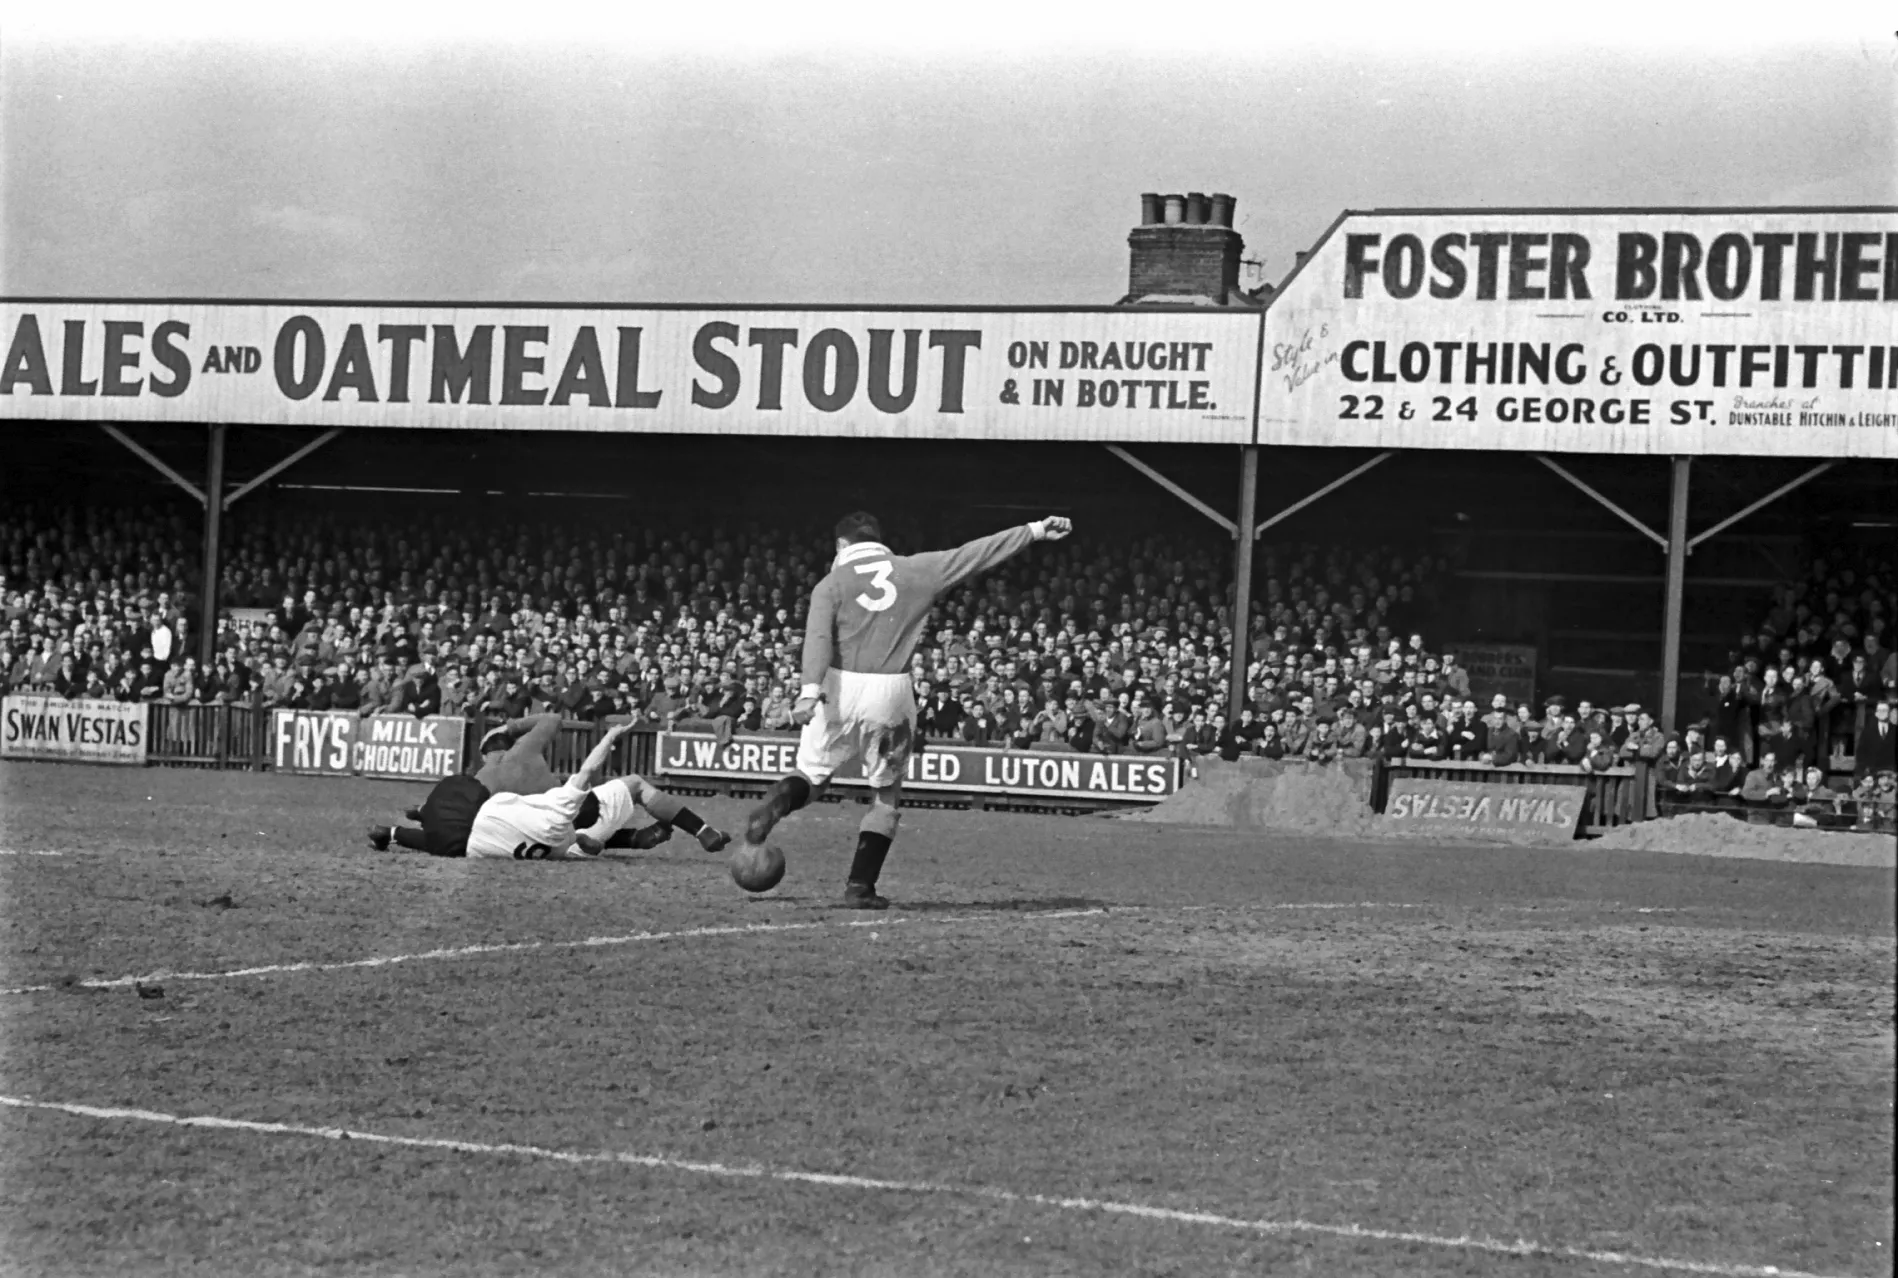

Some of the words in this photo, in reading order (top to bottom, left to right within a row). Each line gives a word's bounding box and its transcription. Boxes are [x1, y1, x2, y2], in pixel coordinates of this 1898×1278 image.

[1343, 231, 1592, 301] FOSTER
[1602, 311, 1634, 324] CO.
[1641, 311, 1684, 324] LTD.
[0, 313, 192, 398] ALES
[201, 345, 262, 374] AND
[273, 315, 662, 409] OATMEAL
[691, 320, 982, 414] STOUT
[1007, 340, 1050, 369] ON
[1059, 340, 1213, 372] DRAUGHT
[1340, 339, 1587, 385] CLOTHING
[1599, 355, 1623, 386] &
[1631, 343, 1898, 390] OUTFITTI
[999, 378, 1020, 405] &
[1032, 379, 1065, 407] IN
[1076, 379, 1217, 411] BOTTLE.
[1338, 394, 1384, 420] 22
[1398, 401, 1416, 421] &
[1432, 395, 1478, 422] 24
[1496, 396, 1651, 425] GEORGE
[1670, 399, 1717, 426] ST.
[1733, 395, 1794, 409] Branches
[1729, 411, 1792, 427] DUNSTABLE
[1800, 411, 1846, 427] HITCHIN
[1858, 411, 1898, 427] LEIGHT
[853, 560, 898, 612] 3
[6, 708, 60, 742] SWAN
[66, 713, 141, 747] VESTAS
[276, 712, 350, 770] FRY'S
[371, 720, 437, 745] MILK
[353, 742, 455, 776] CHOCOLATE
[669, 740, 802, 774] J.W.GREE
[985, 755, 1085, 789] LUTON
[1090, 763, 1166, 794] ALES
[1391, 793, 1492, 822] VESTAS
[1499, 798, 1573, 829] SWAN
